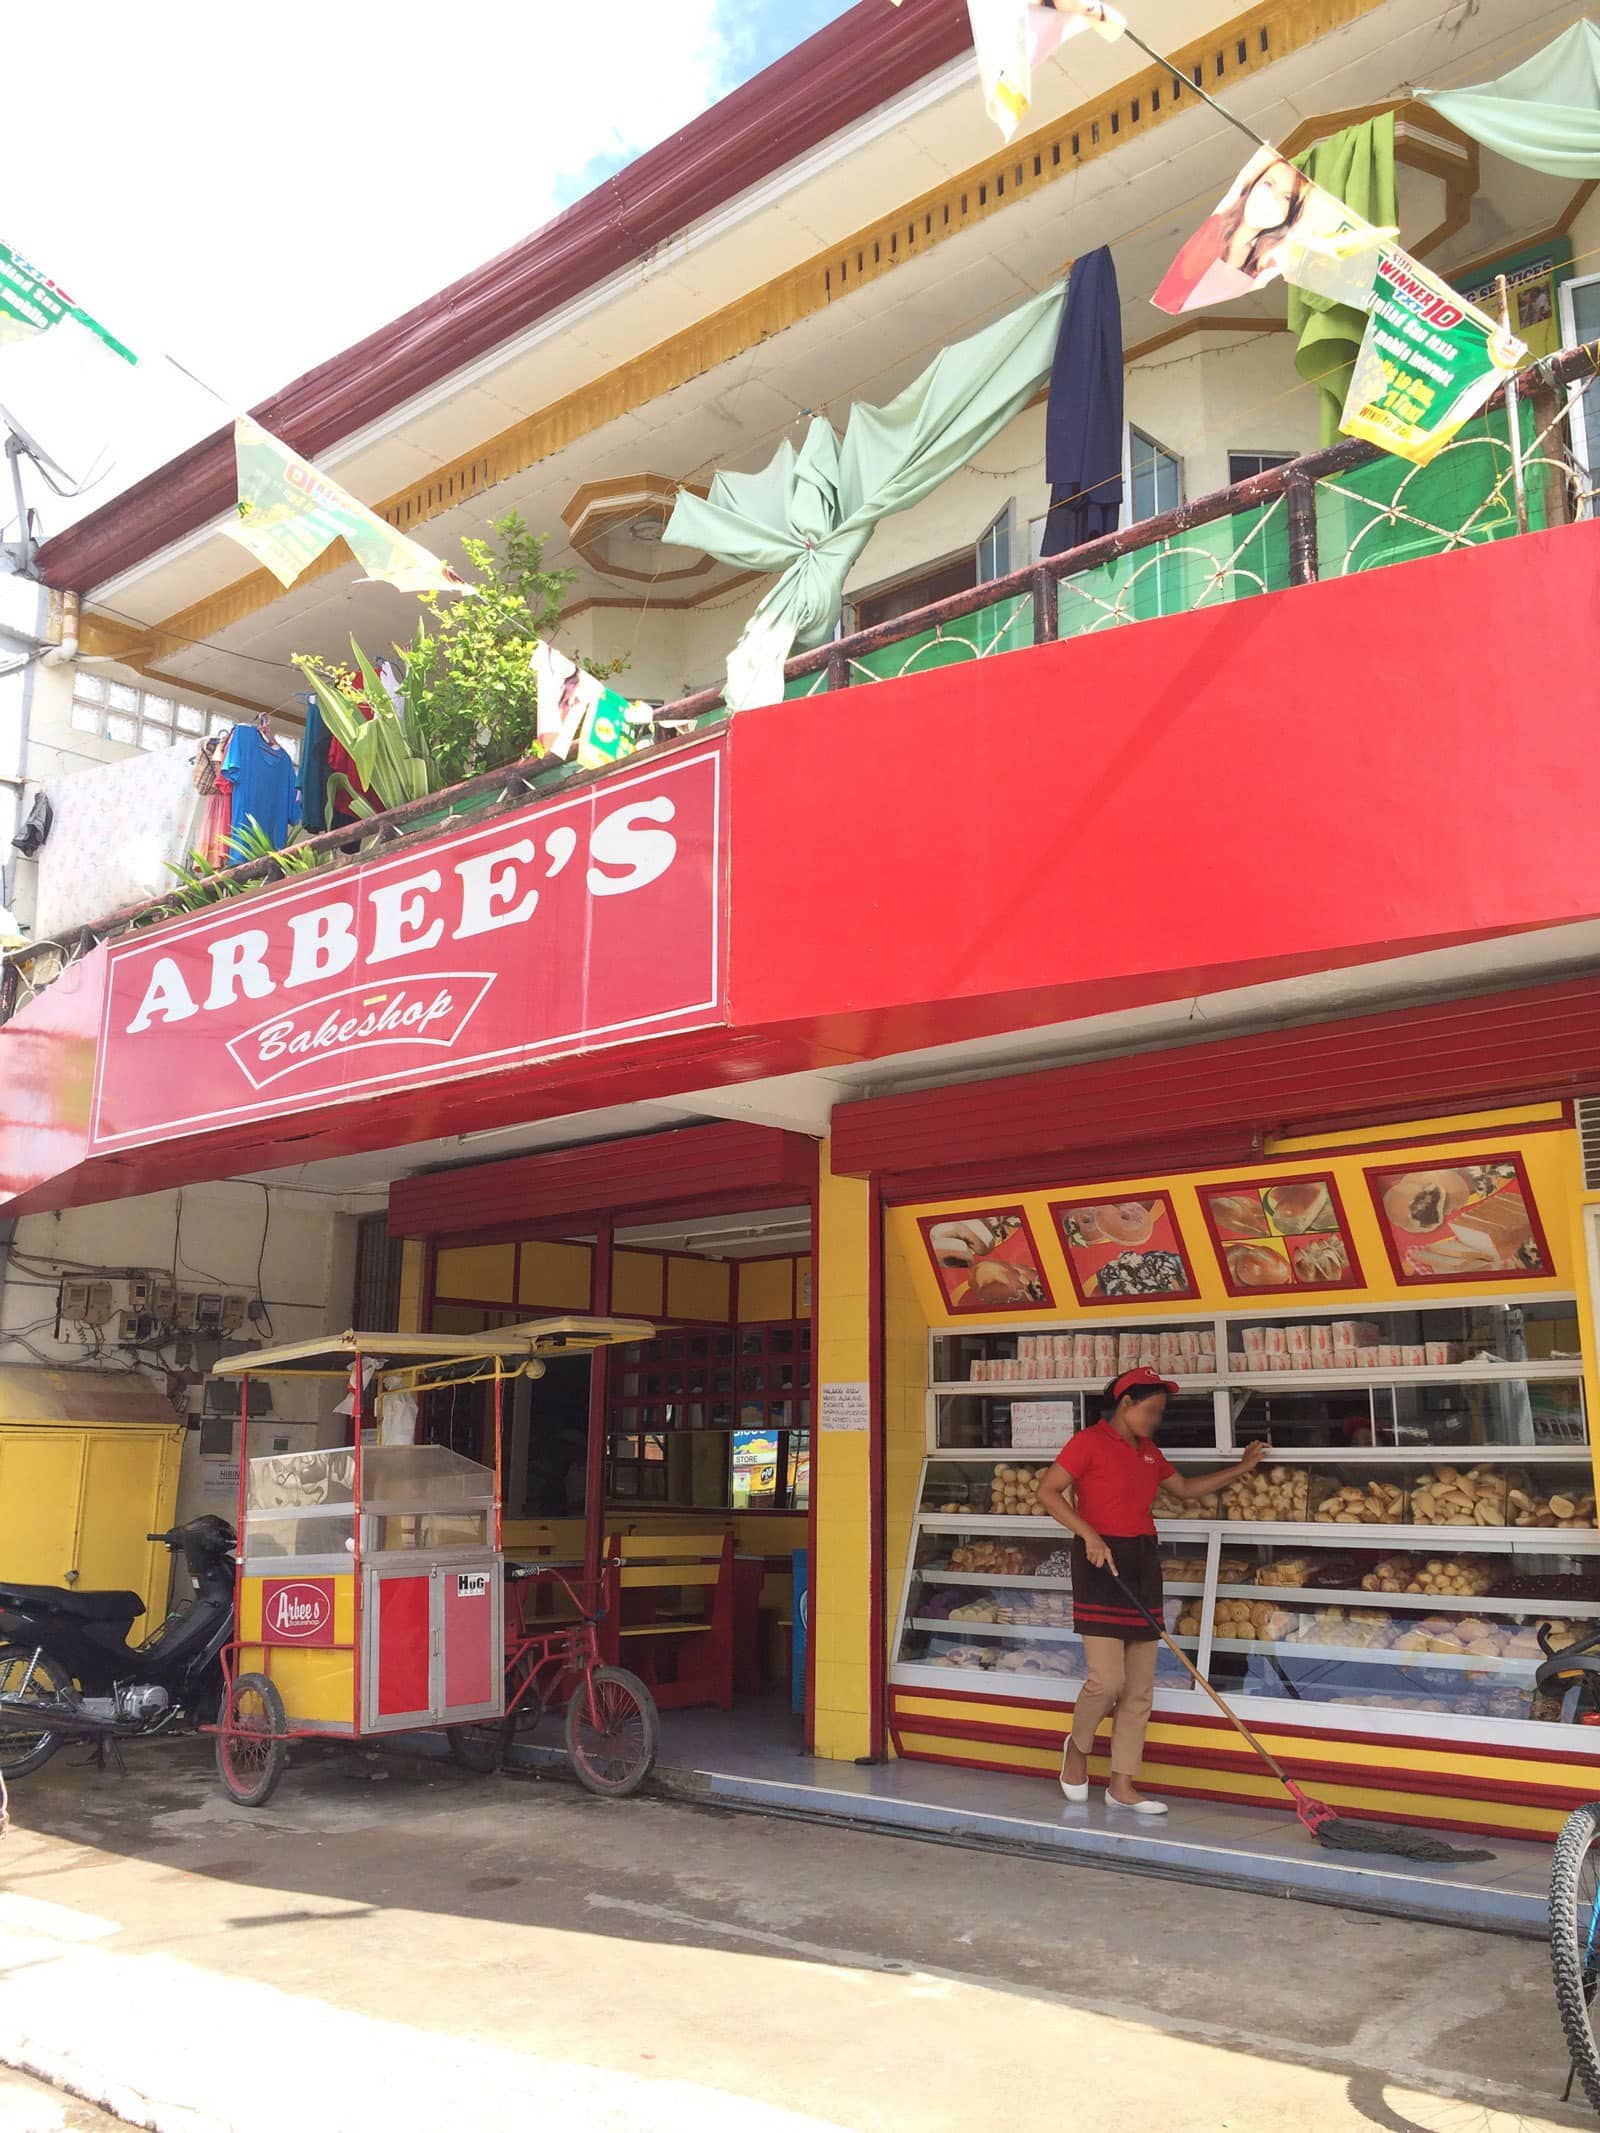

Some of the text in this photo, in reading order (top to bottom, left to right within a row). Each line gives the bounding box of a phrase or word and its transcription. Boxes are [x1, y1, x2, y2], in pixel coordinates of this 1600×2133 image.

[1379, 260, 1463, 329] WINNER 10
[1394, 289, 1424, 312] TXT
[125, 795, 678, 1035] ARBEE'S
[257, 988, 454, 1063] Bakeshop
[735, 1455, 758, 1463] STORE
